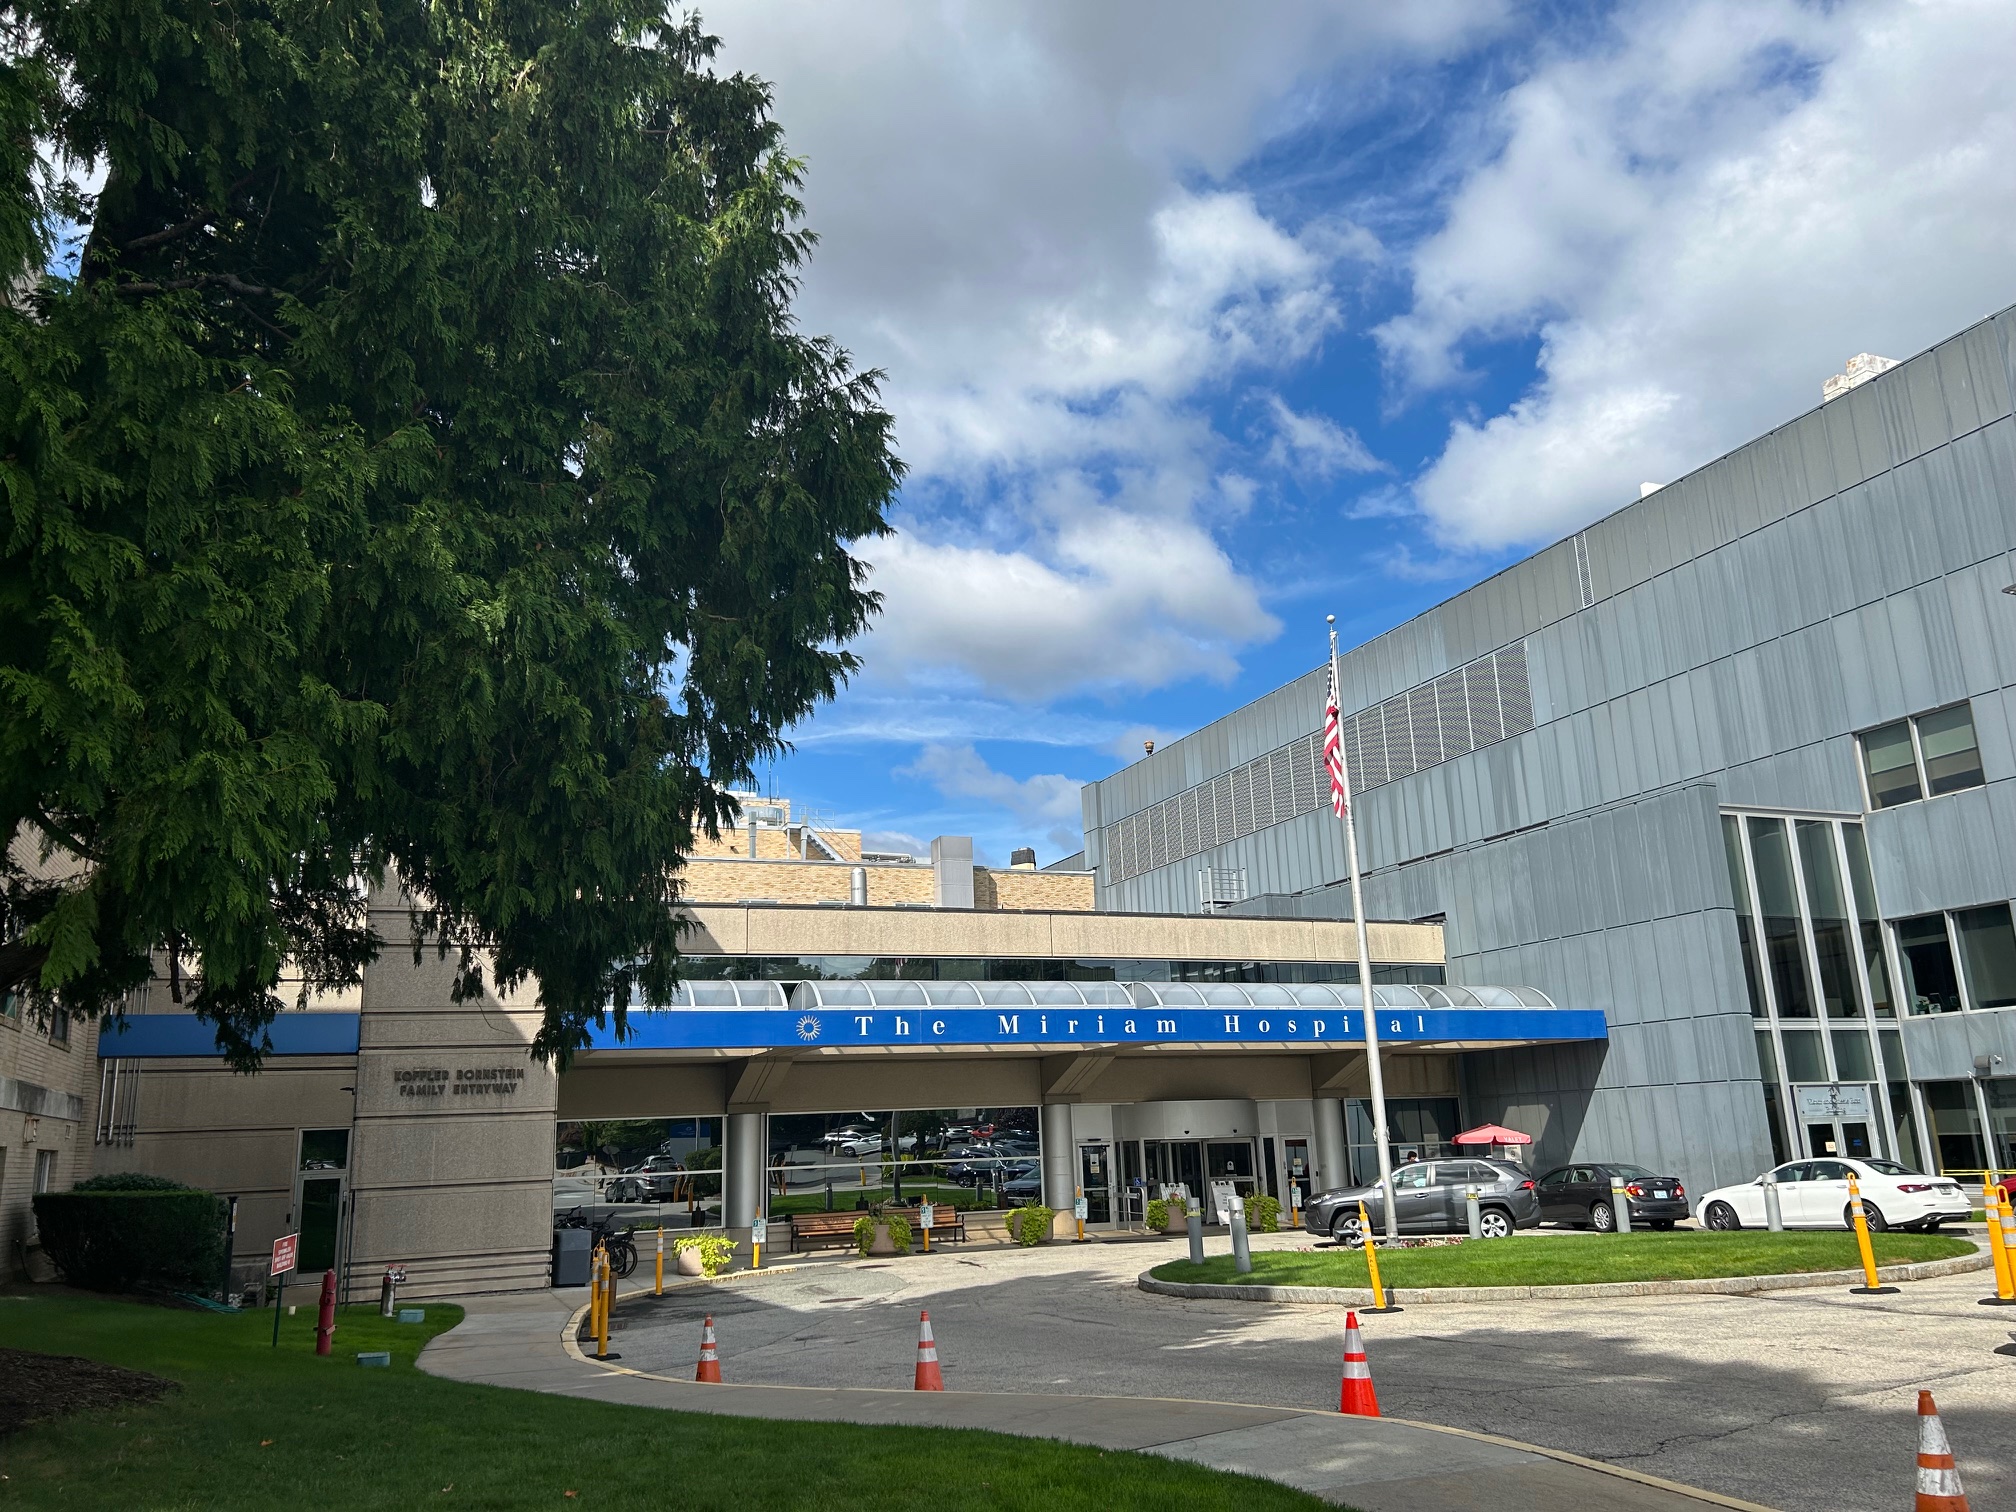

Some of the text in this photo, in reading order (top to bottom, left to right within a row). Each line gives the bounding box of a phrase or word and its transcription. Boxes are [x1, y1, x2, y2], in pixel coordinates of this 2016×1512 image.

[854, 1014, 1425, 1037] The Miriam Hospial
[394, 1068, 525, 1082] KOFFLER BORNSTEIN
[400, 1082, 518, 1096] FAMILY ENTRYWAY
